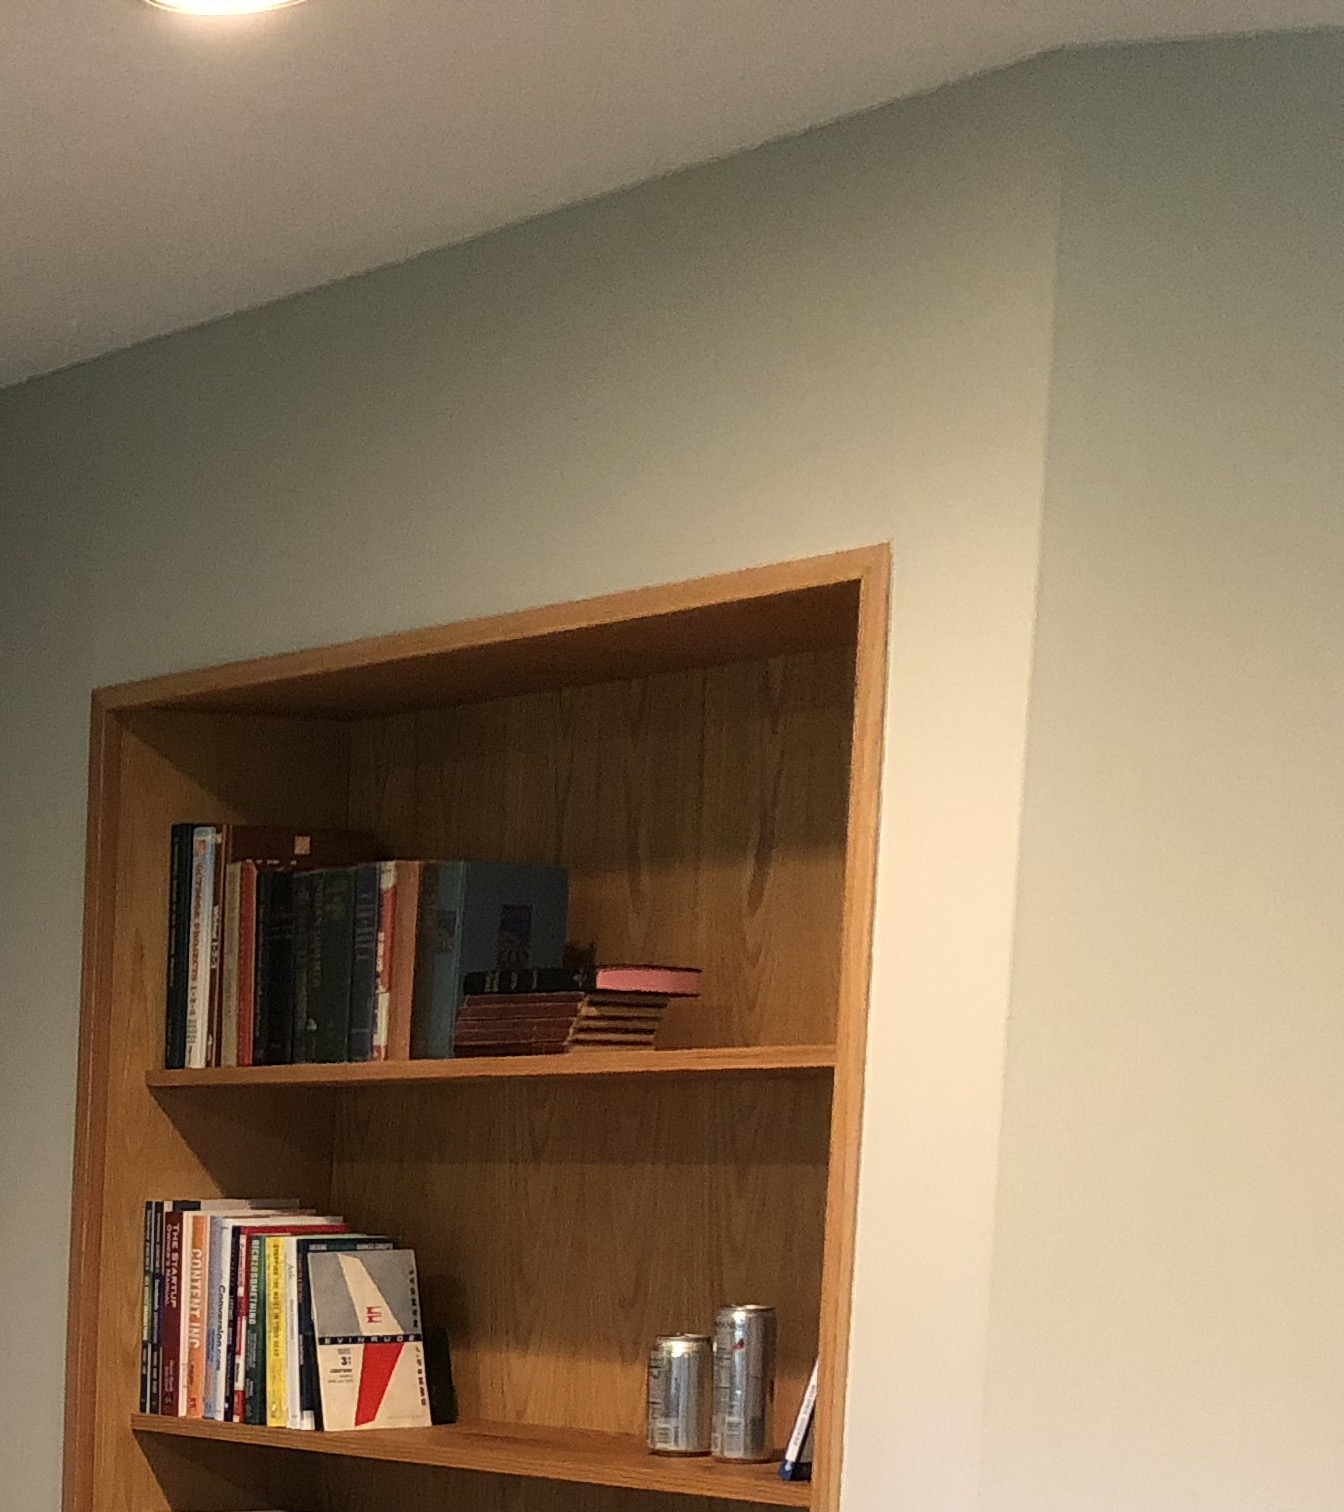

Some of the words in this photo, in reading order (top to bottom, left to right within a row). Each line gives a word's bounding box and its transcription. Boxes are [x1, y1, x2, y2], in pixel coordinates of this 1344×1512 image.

[171, 1223, 180, 1248] THE
[170, 1252, 179, 1308] STARTUP
[190, 1248, 203, 1318] CONTENT
[324, 1333, 416, 1344] EVINRUDE
